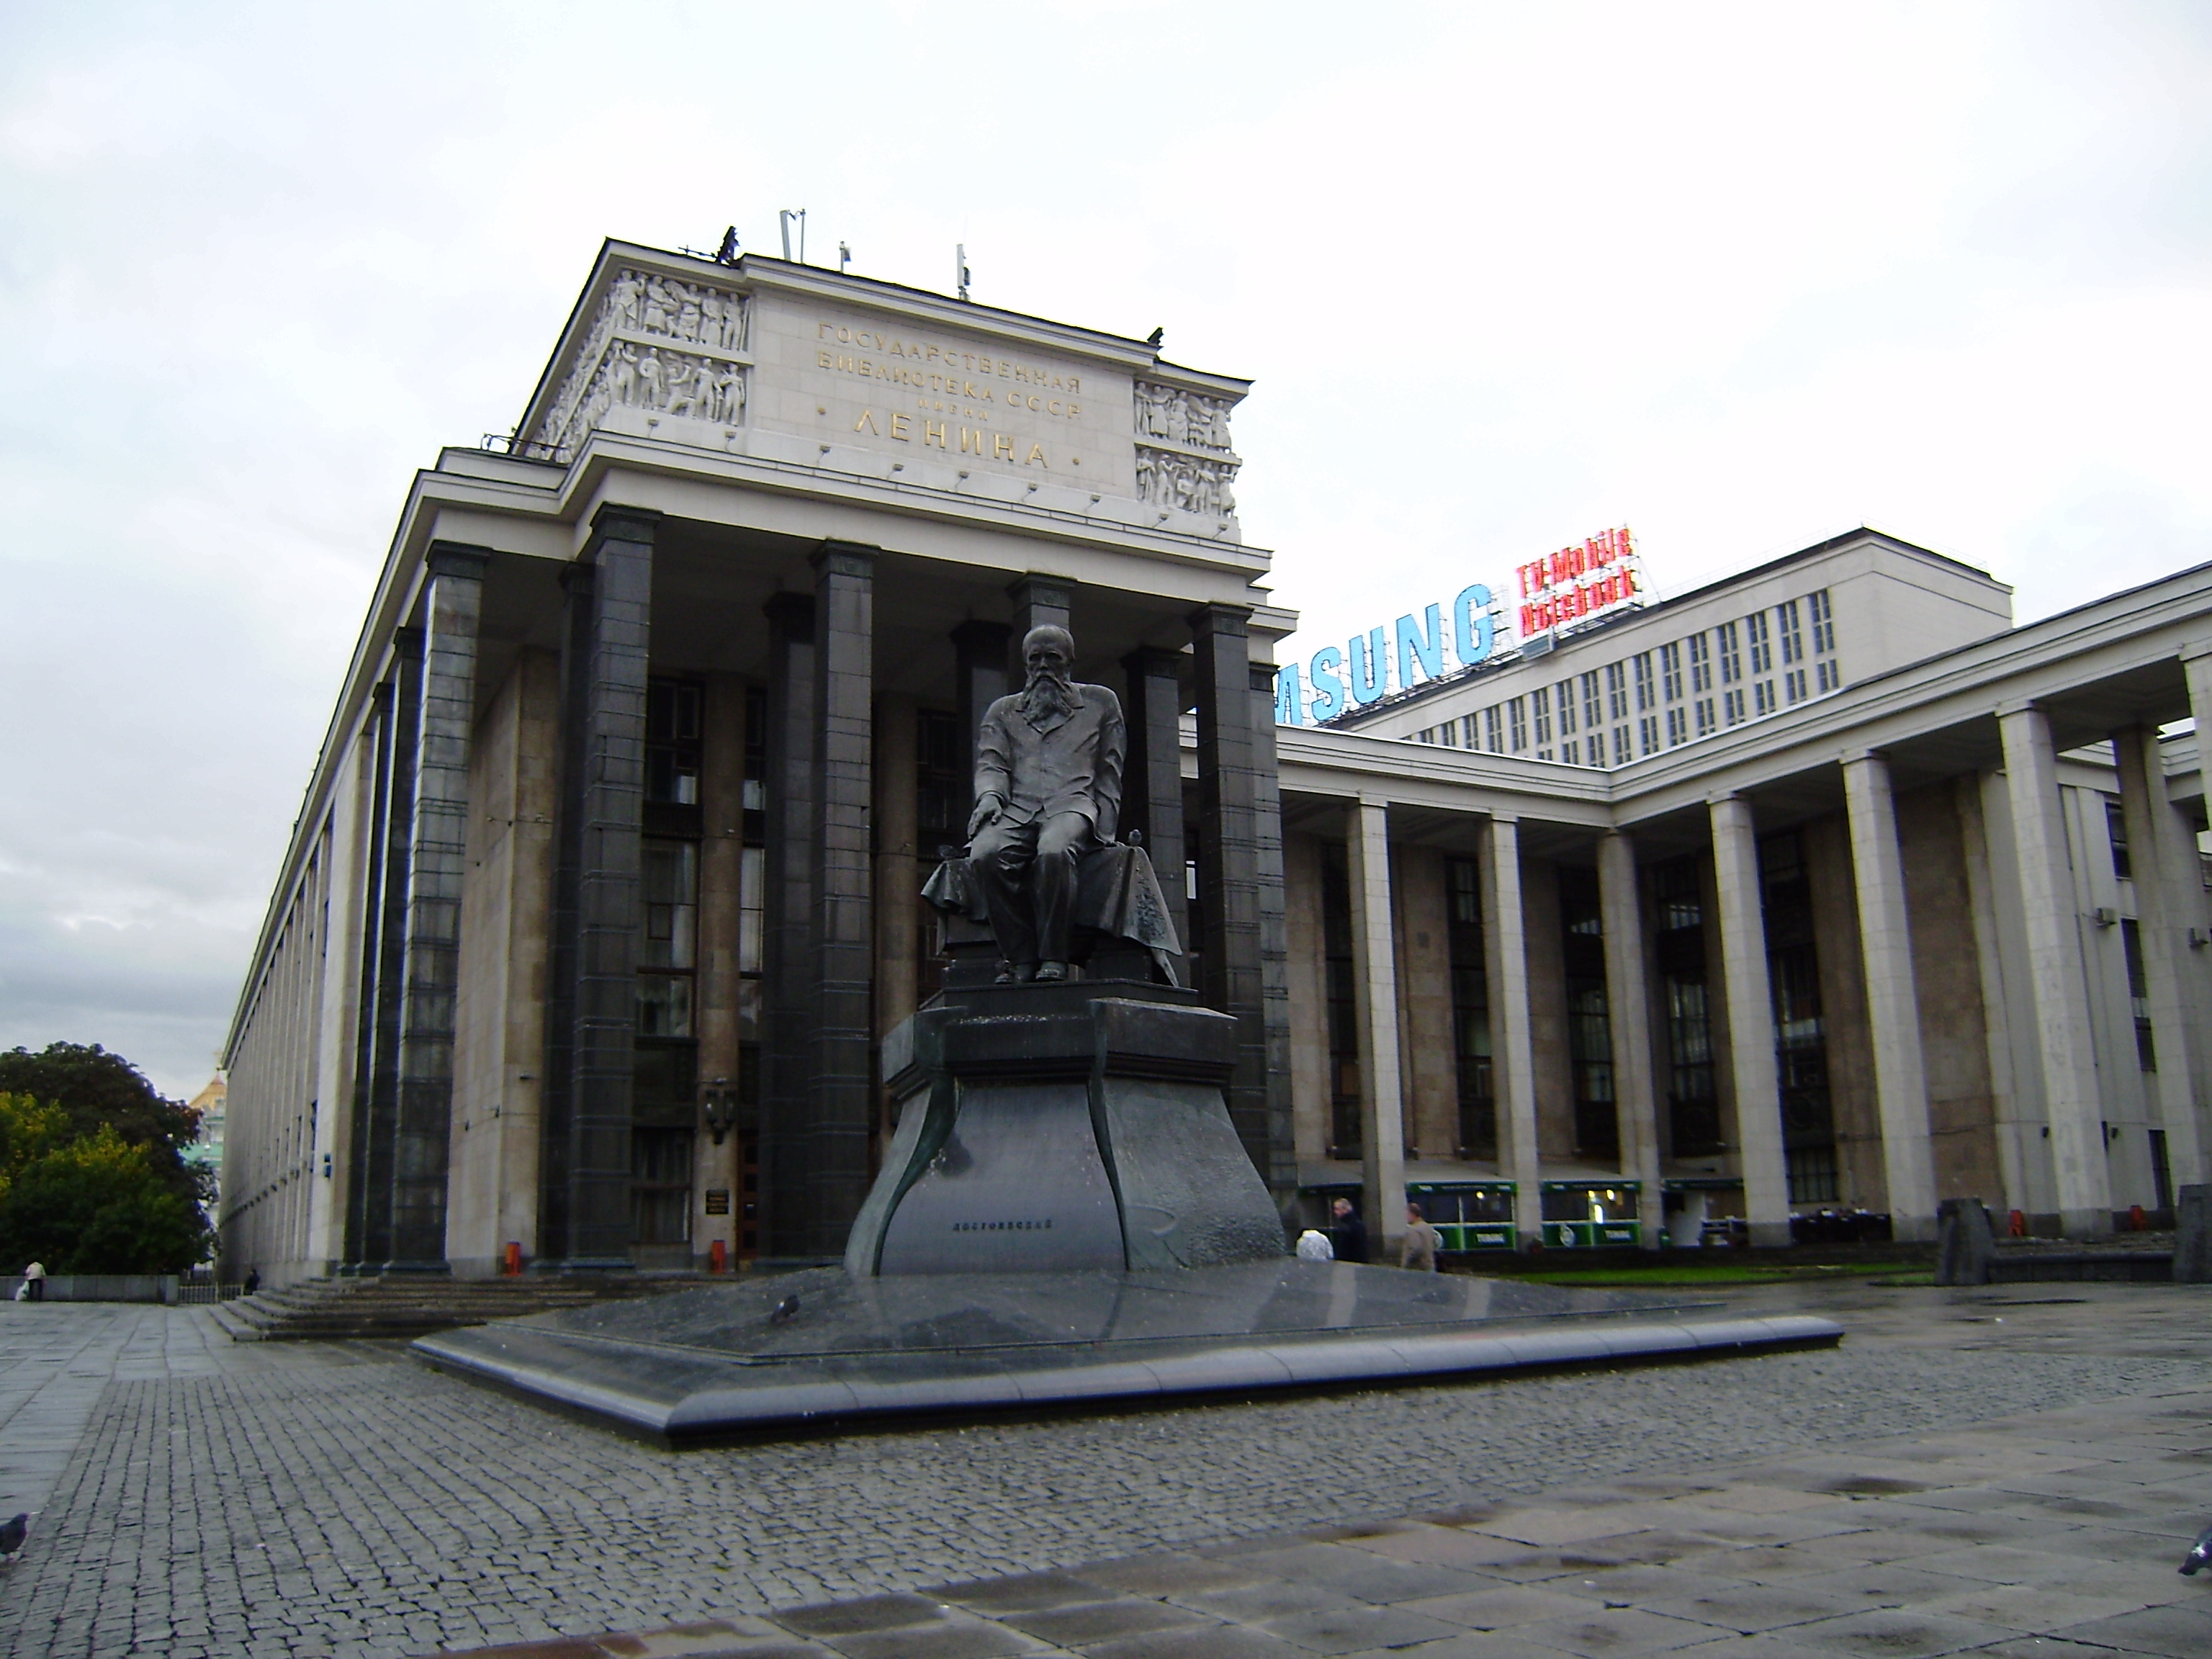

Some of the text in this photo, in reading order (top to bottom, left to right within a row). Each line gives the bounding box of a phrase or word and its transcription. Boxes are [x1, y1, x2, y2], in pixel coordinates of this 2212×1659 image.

[818, 351, 994, 403] БИБЛИОТЕКА
[819, 322, 1080, 393] ГОСУДАРСТВЕННАЯ
[854, 410, 1048, 468] ЛЕНИНА
[1519, 565, 1634, 638] Notebook
